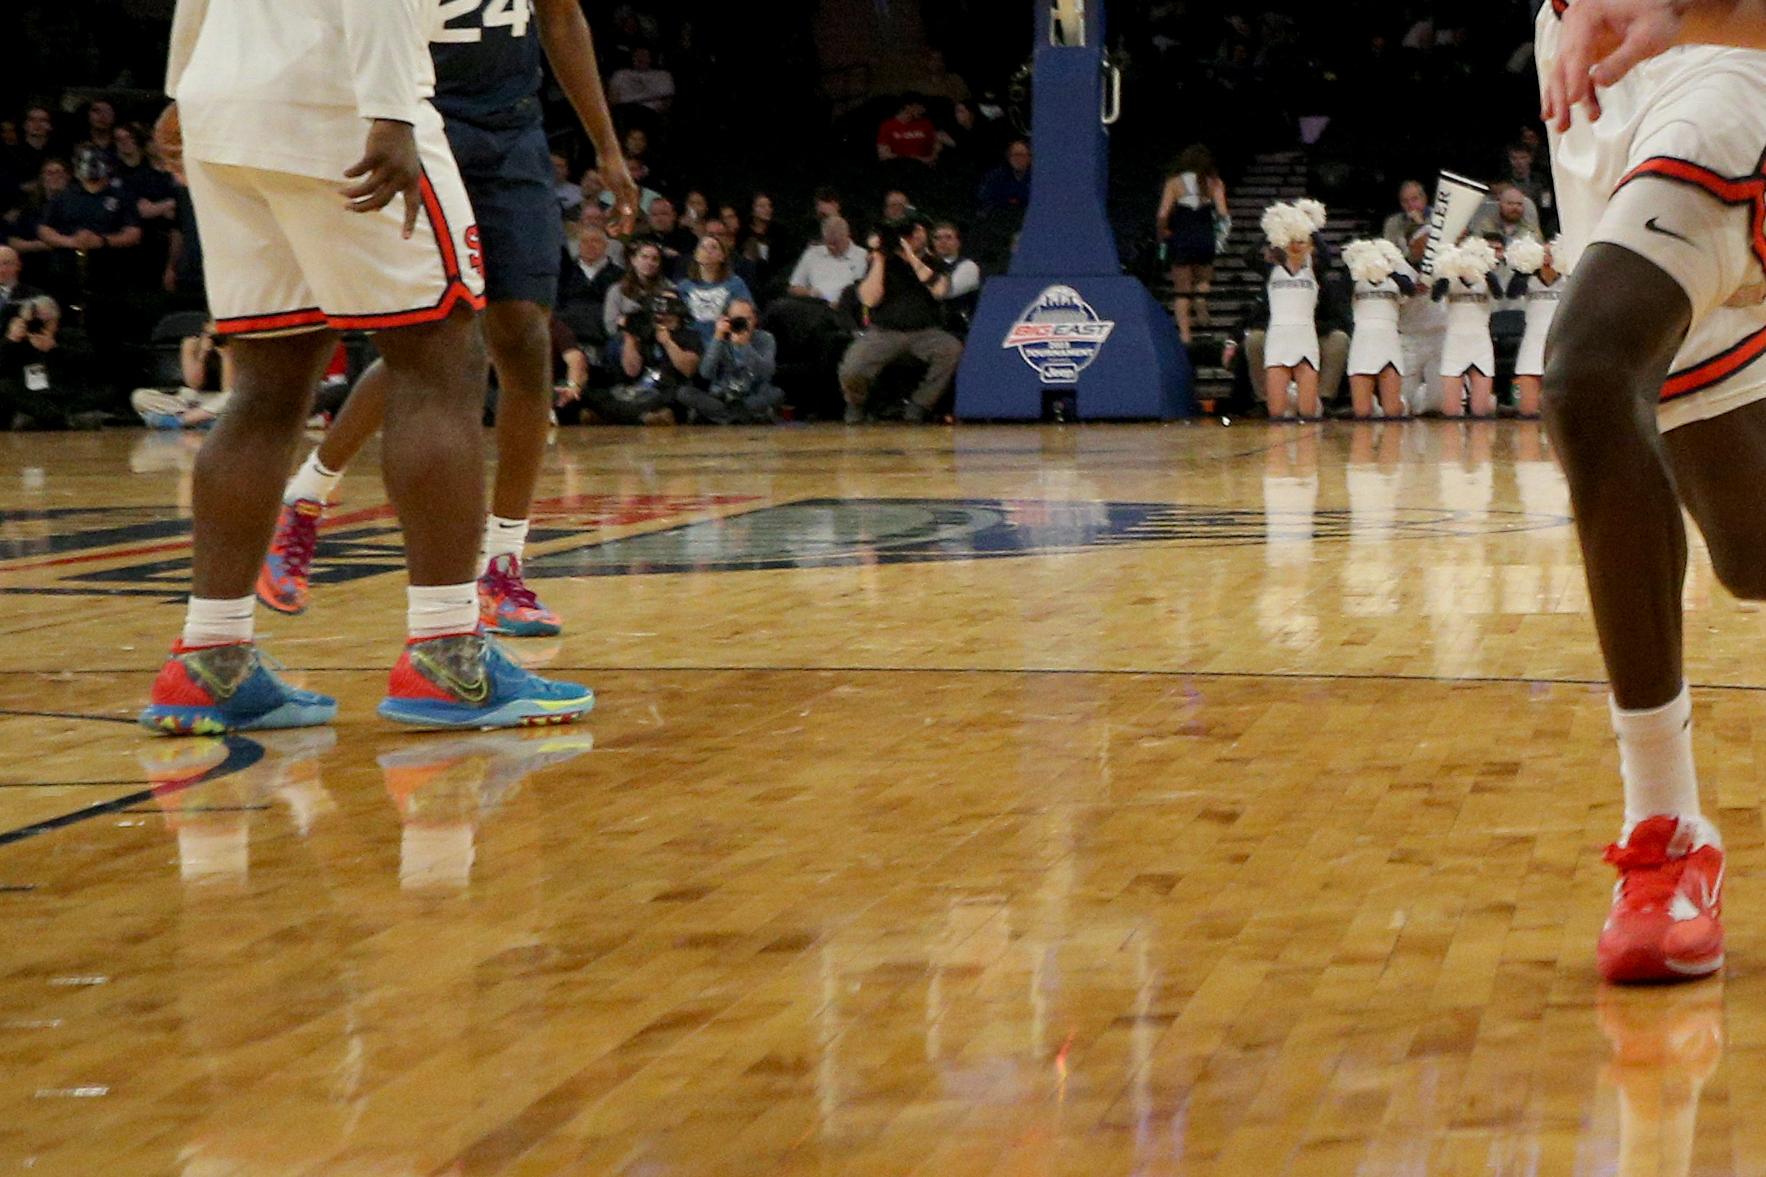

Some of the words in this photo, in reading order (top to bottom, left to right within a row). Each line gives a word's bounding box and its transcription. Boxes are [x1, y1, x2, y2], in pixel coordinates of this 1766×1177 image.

[1420, 190, 1452, 276] BUTLER
[1014, 324, 1051, 336] BIG
[1053, 323, 1108, 336] EAST
